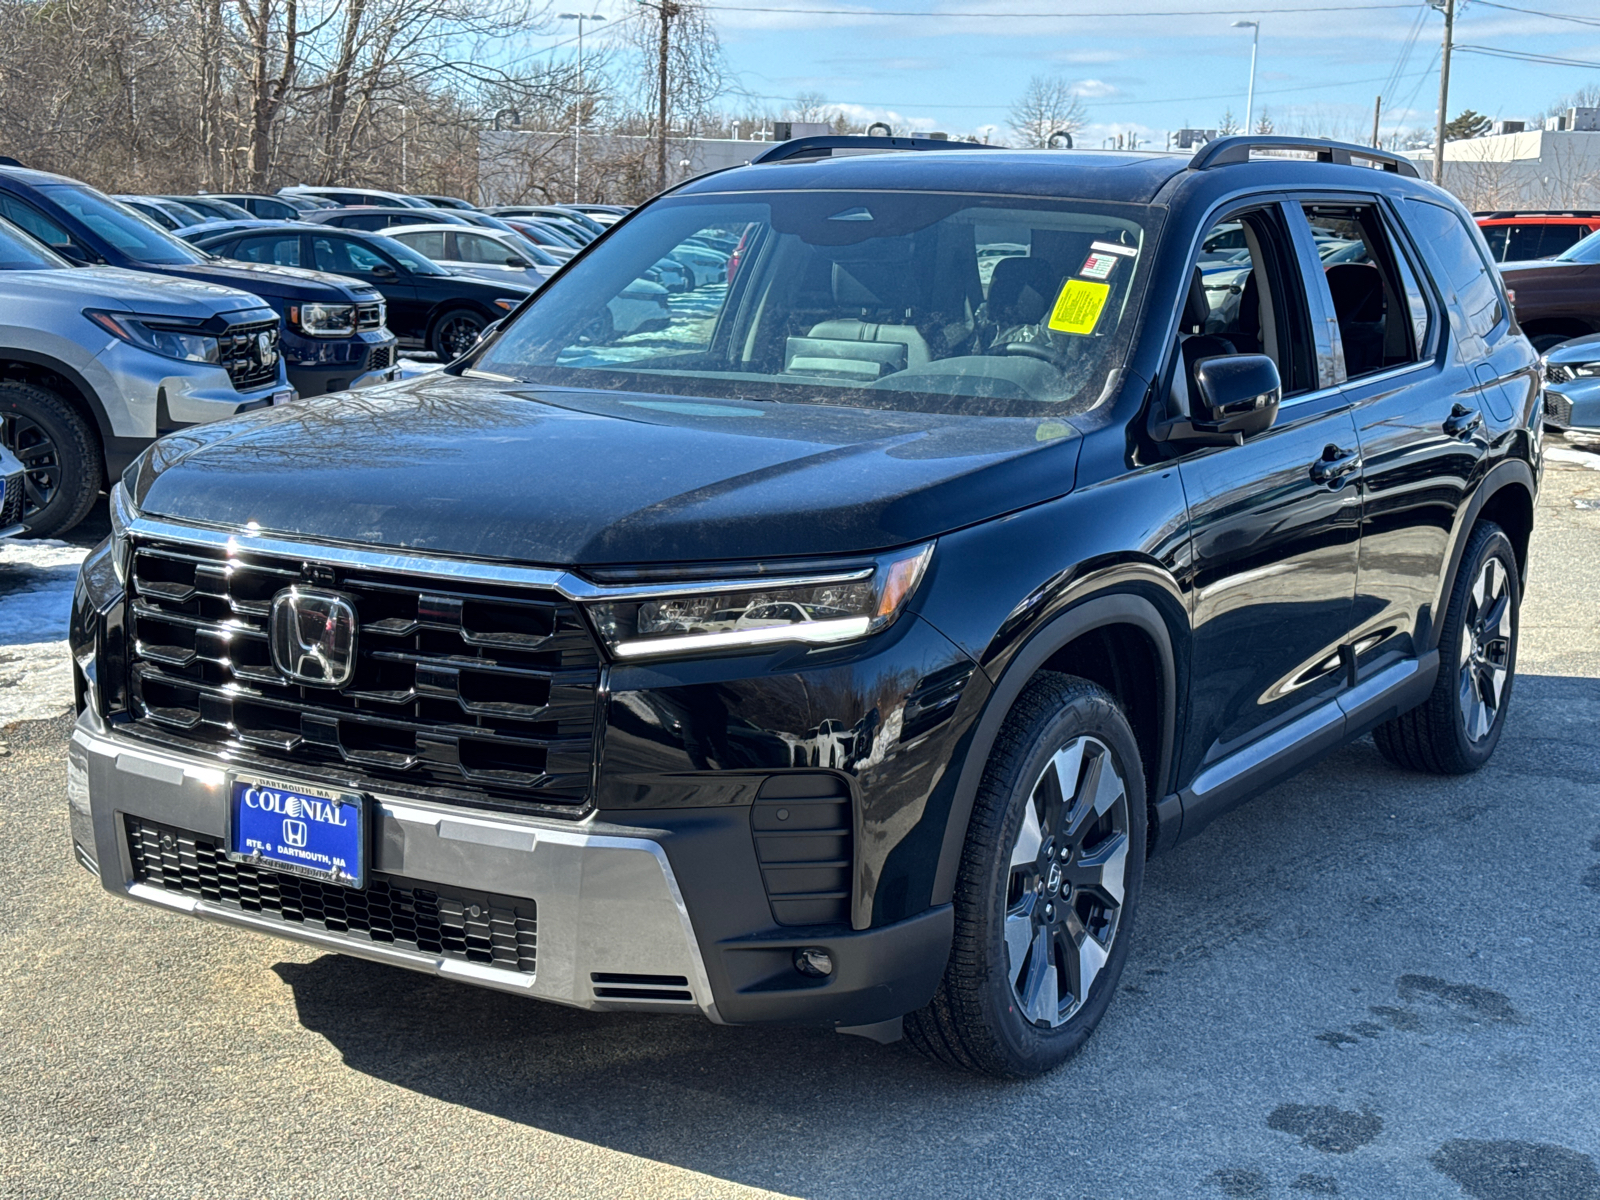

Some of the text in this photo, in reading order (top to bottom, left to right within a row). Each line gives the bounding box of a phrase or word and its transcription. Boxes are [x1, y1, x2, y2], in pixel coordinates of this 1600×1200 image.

[245, 788, 347, 827] COLONIAL
[316, 790, 330, 798] MA
[246, 838, 346, 868] RTE. 6 DARTMOUTH, MA
